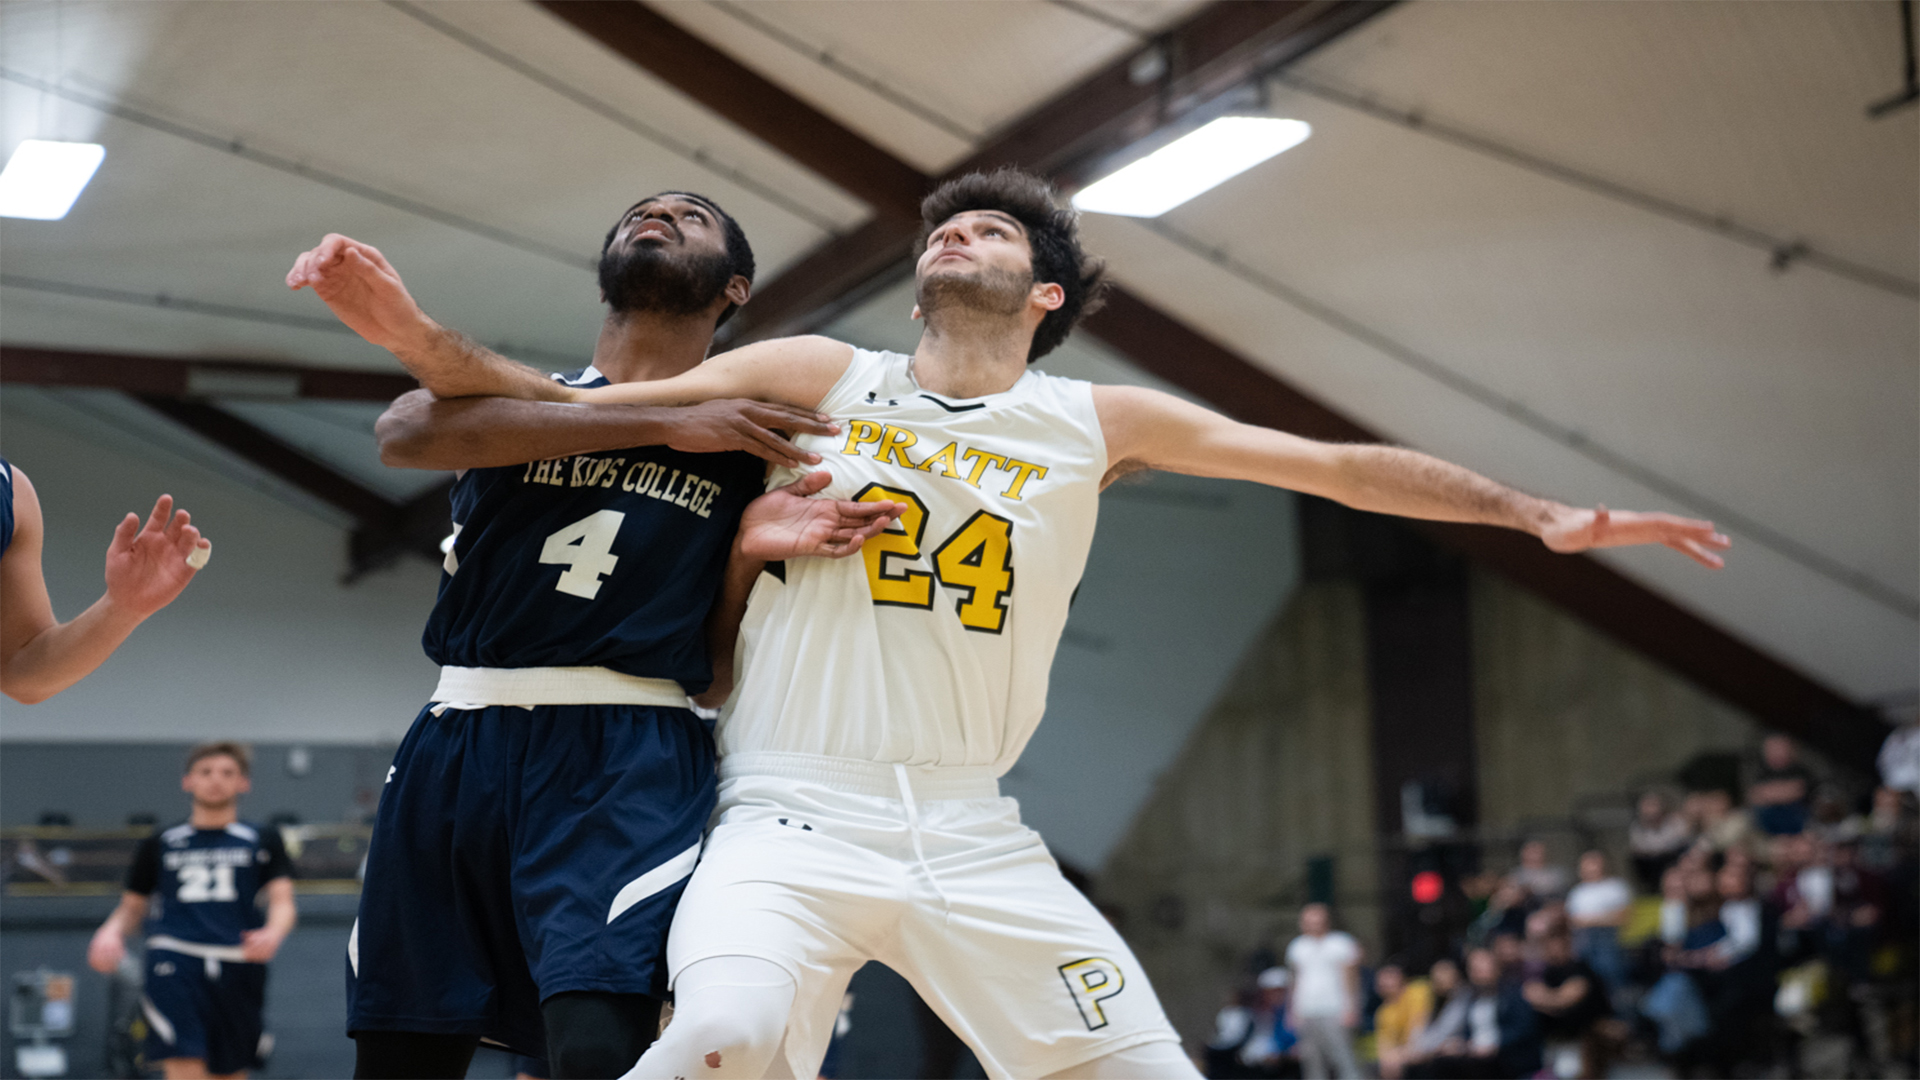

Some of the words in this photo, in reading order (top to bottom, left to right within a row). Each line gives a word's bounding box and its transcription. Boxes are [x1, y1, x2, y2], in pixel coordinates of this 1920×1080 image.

[622, 461, 722, 519] COLLEGE
[840, 419, 1049, 501] PRATT
[538, 509, 626, 600] 4
[851, 481, 1015, 636] 24
[177, 863, 239, 903] 21
[1057, 957, 1125, 1032] P
